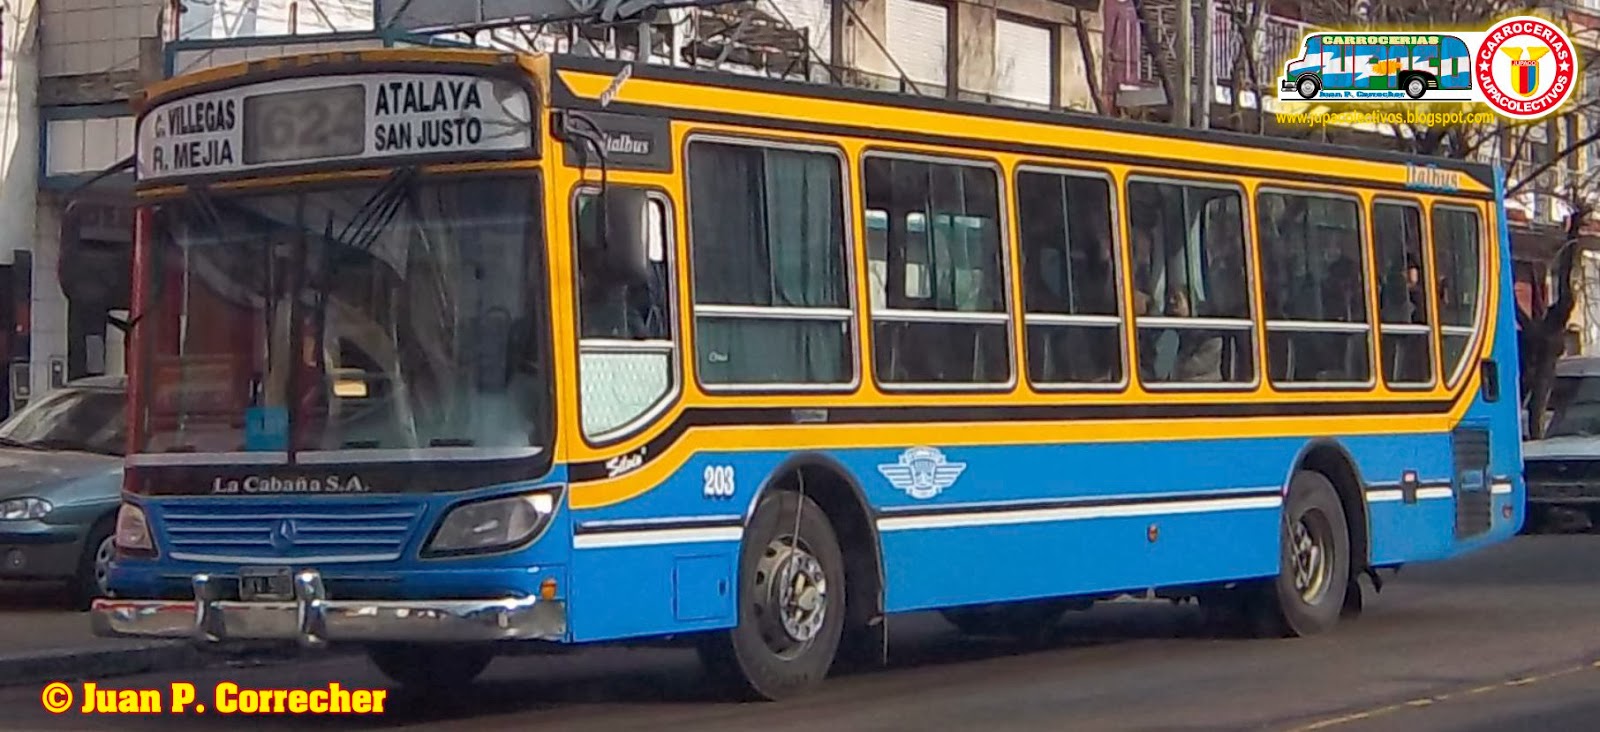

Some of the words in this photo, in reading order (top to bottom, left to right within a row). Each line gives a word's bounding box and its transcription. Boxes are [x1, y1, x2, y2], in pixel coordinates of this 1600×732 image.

[375, 81, 482, 116] ATALAYA
[168, 99, 235, 136] VILLEGAS
[375, 122, 411, 151] SAN
[417, 117, 482, 148] JUSTO
[153, 145, 168, 171] R.
[174, 139, 233, 169] MEJIA
[213, 476, 240, 492] La
[243, 475, 321, 492] Cabaña
[325, 475, 370, 492] S.A.
[703, 464, 735, 497] 203
